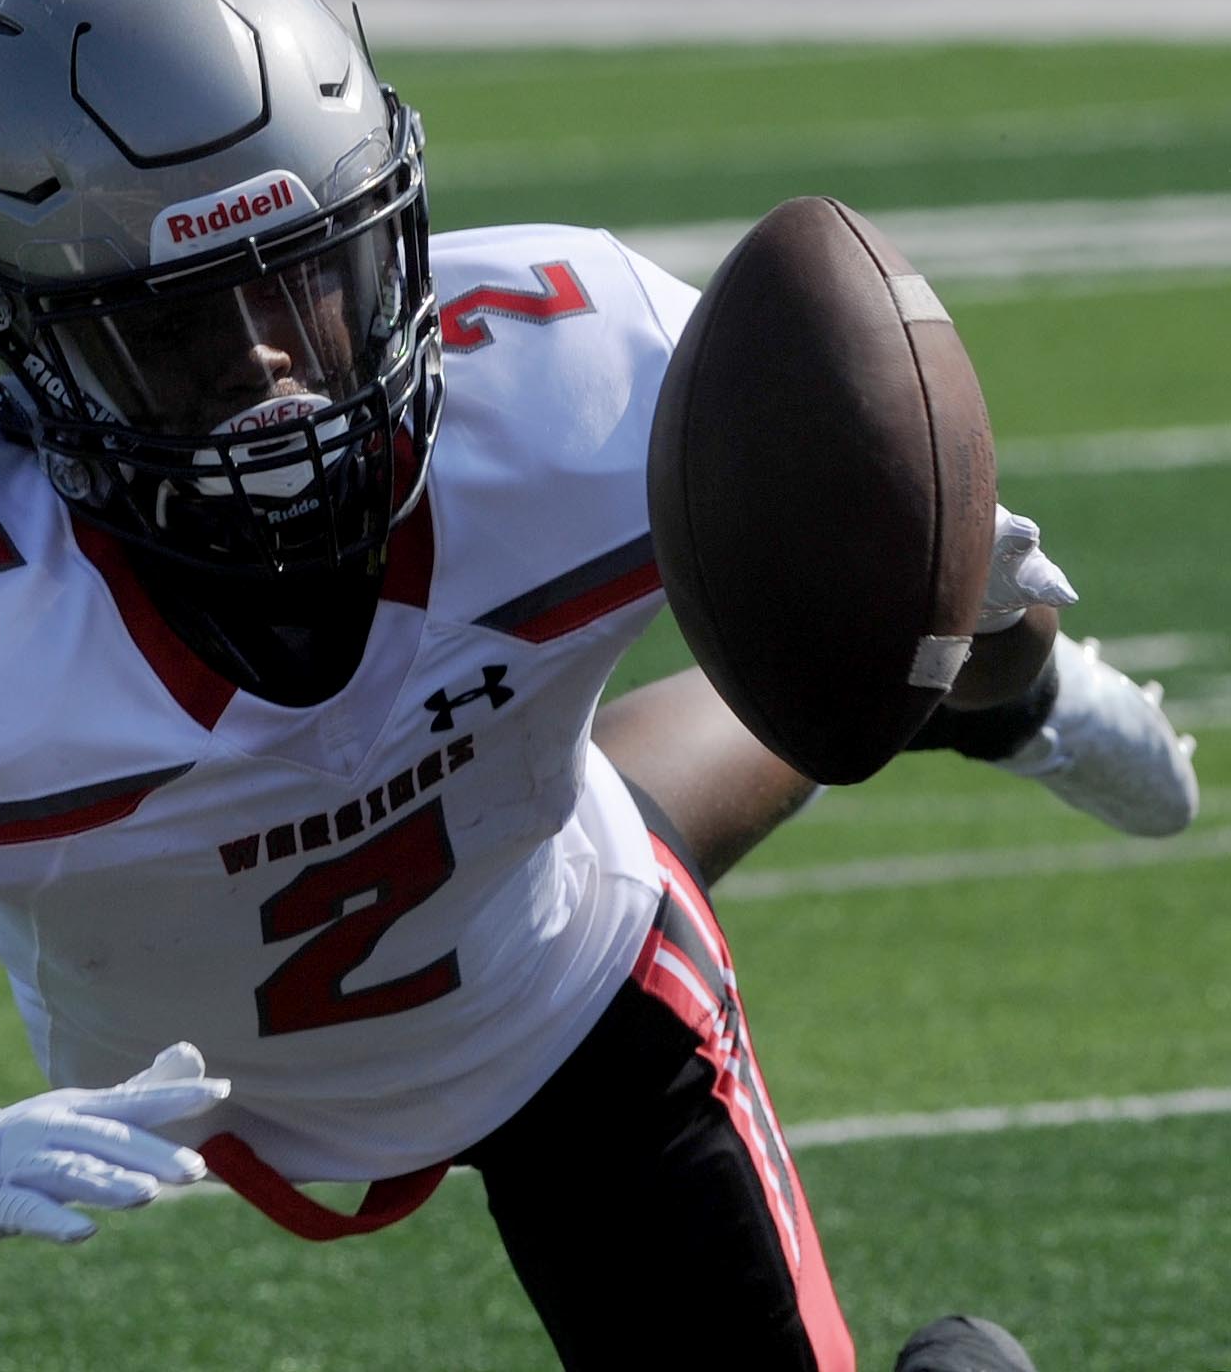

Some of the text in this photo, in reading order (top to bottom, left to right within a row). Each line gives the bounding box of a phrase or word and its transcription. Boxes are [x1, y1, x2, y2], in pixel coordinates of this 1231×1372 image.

[166, 179, 294, 244] Riddell
[439, 259, 597, 354] 2
[218, 734, 475, 876] WARRIORS
[254, 794, 462, 1038] 2
